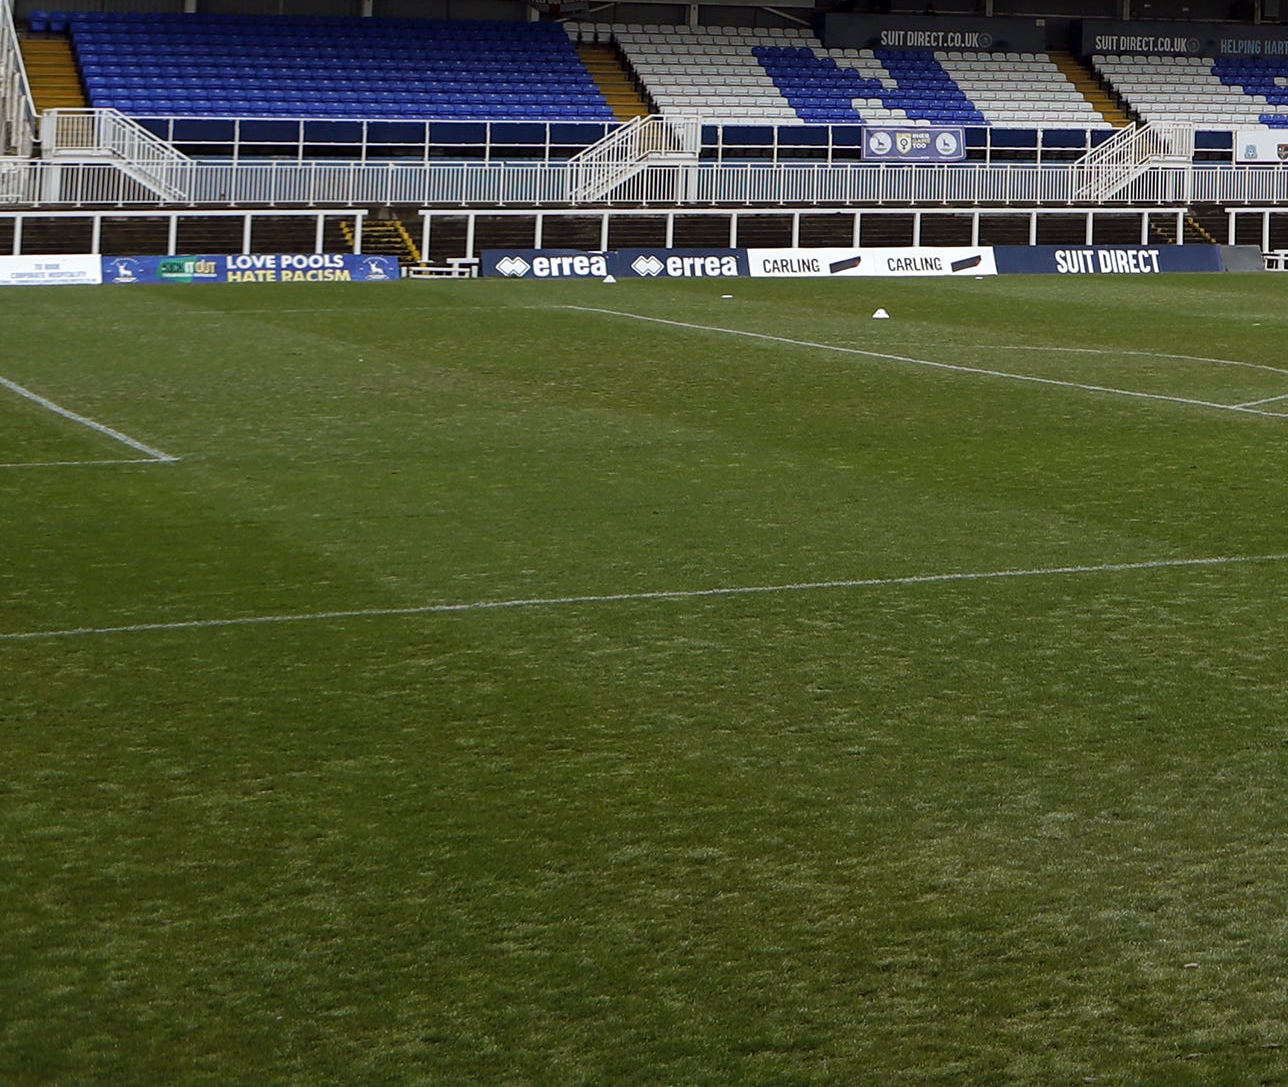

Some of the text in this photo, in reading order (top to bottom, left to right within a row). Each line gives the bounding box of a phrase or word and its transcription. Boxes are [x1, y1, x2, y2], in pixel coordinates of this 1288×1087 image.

[880, 30, 980, 48] SUIT DIRECT.CO.UK
[1095, 35, 1188, 52] SUIT DIRECT.CO.UK
[1220, 38, 1262, 55] HELPING
[226, 255, 276, 269] LOVE
[280, 254, 345, 269] POOLS
[762, 257, 820, 274] CARLING
[887, 256, 942, 273] CARLING
[1054, 249, 1160, 274] SUIT DIRECT
[226, 269, 352, 282] HATE RACISM
